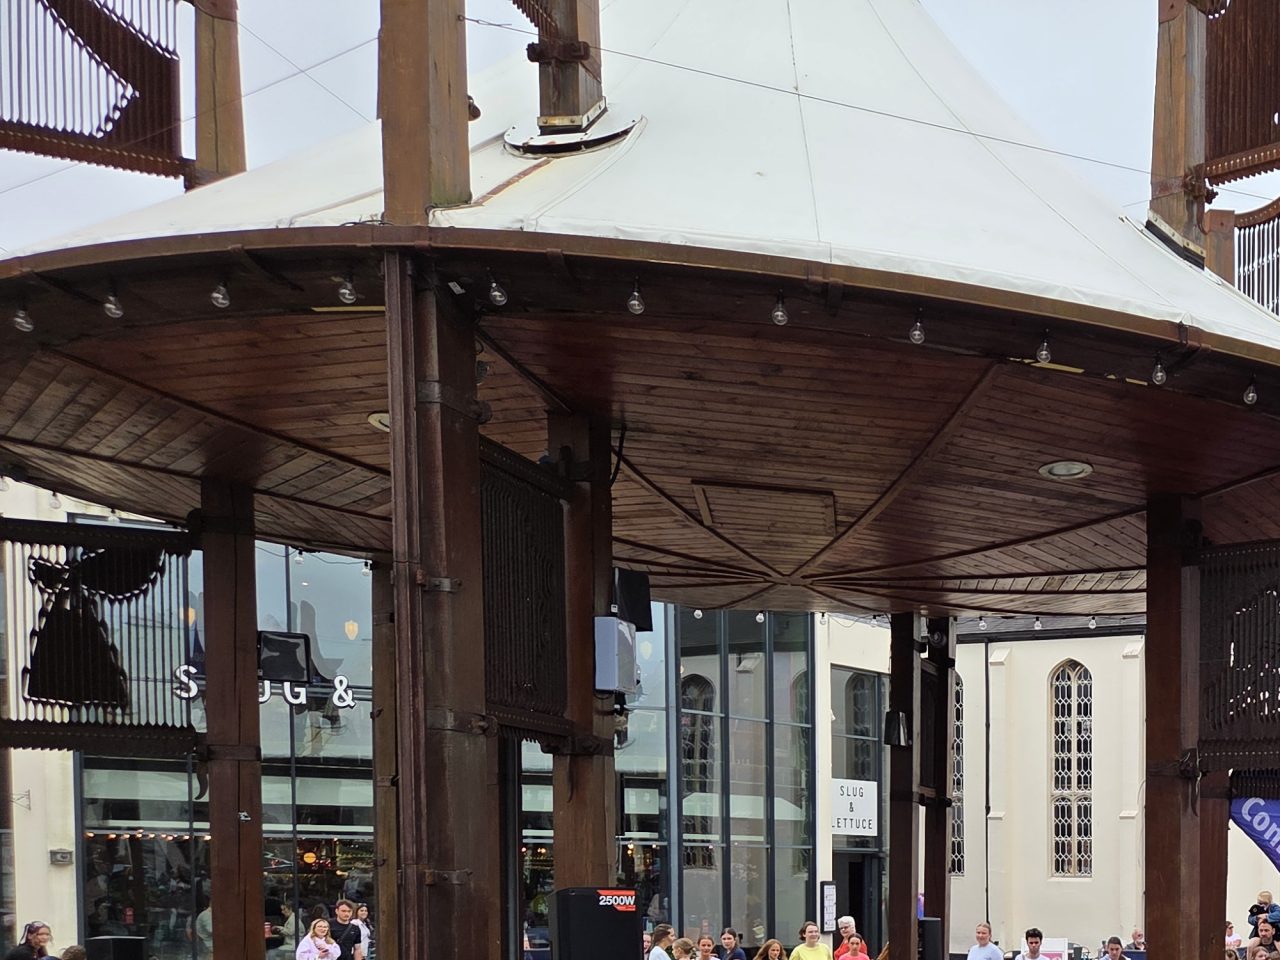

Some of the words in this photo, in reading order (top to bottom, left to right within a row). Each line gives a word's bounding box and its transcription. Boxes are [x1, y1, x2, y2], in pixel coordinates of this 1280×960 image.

[332, 675, 355, 707] &
[840, 785, 864, 798] SLUG
[849, 801, 854, 813] &
[599, 895, 636, 906] 2500W
